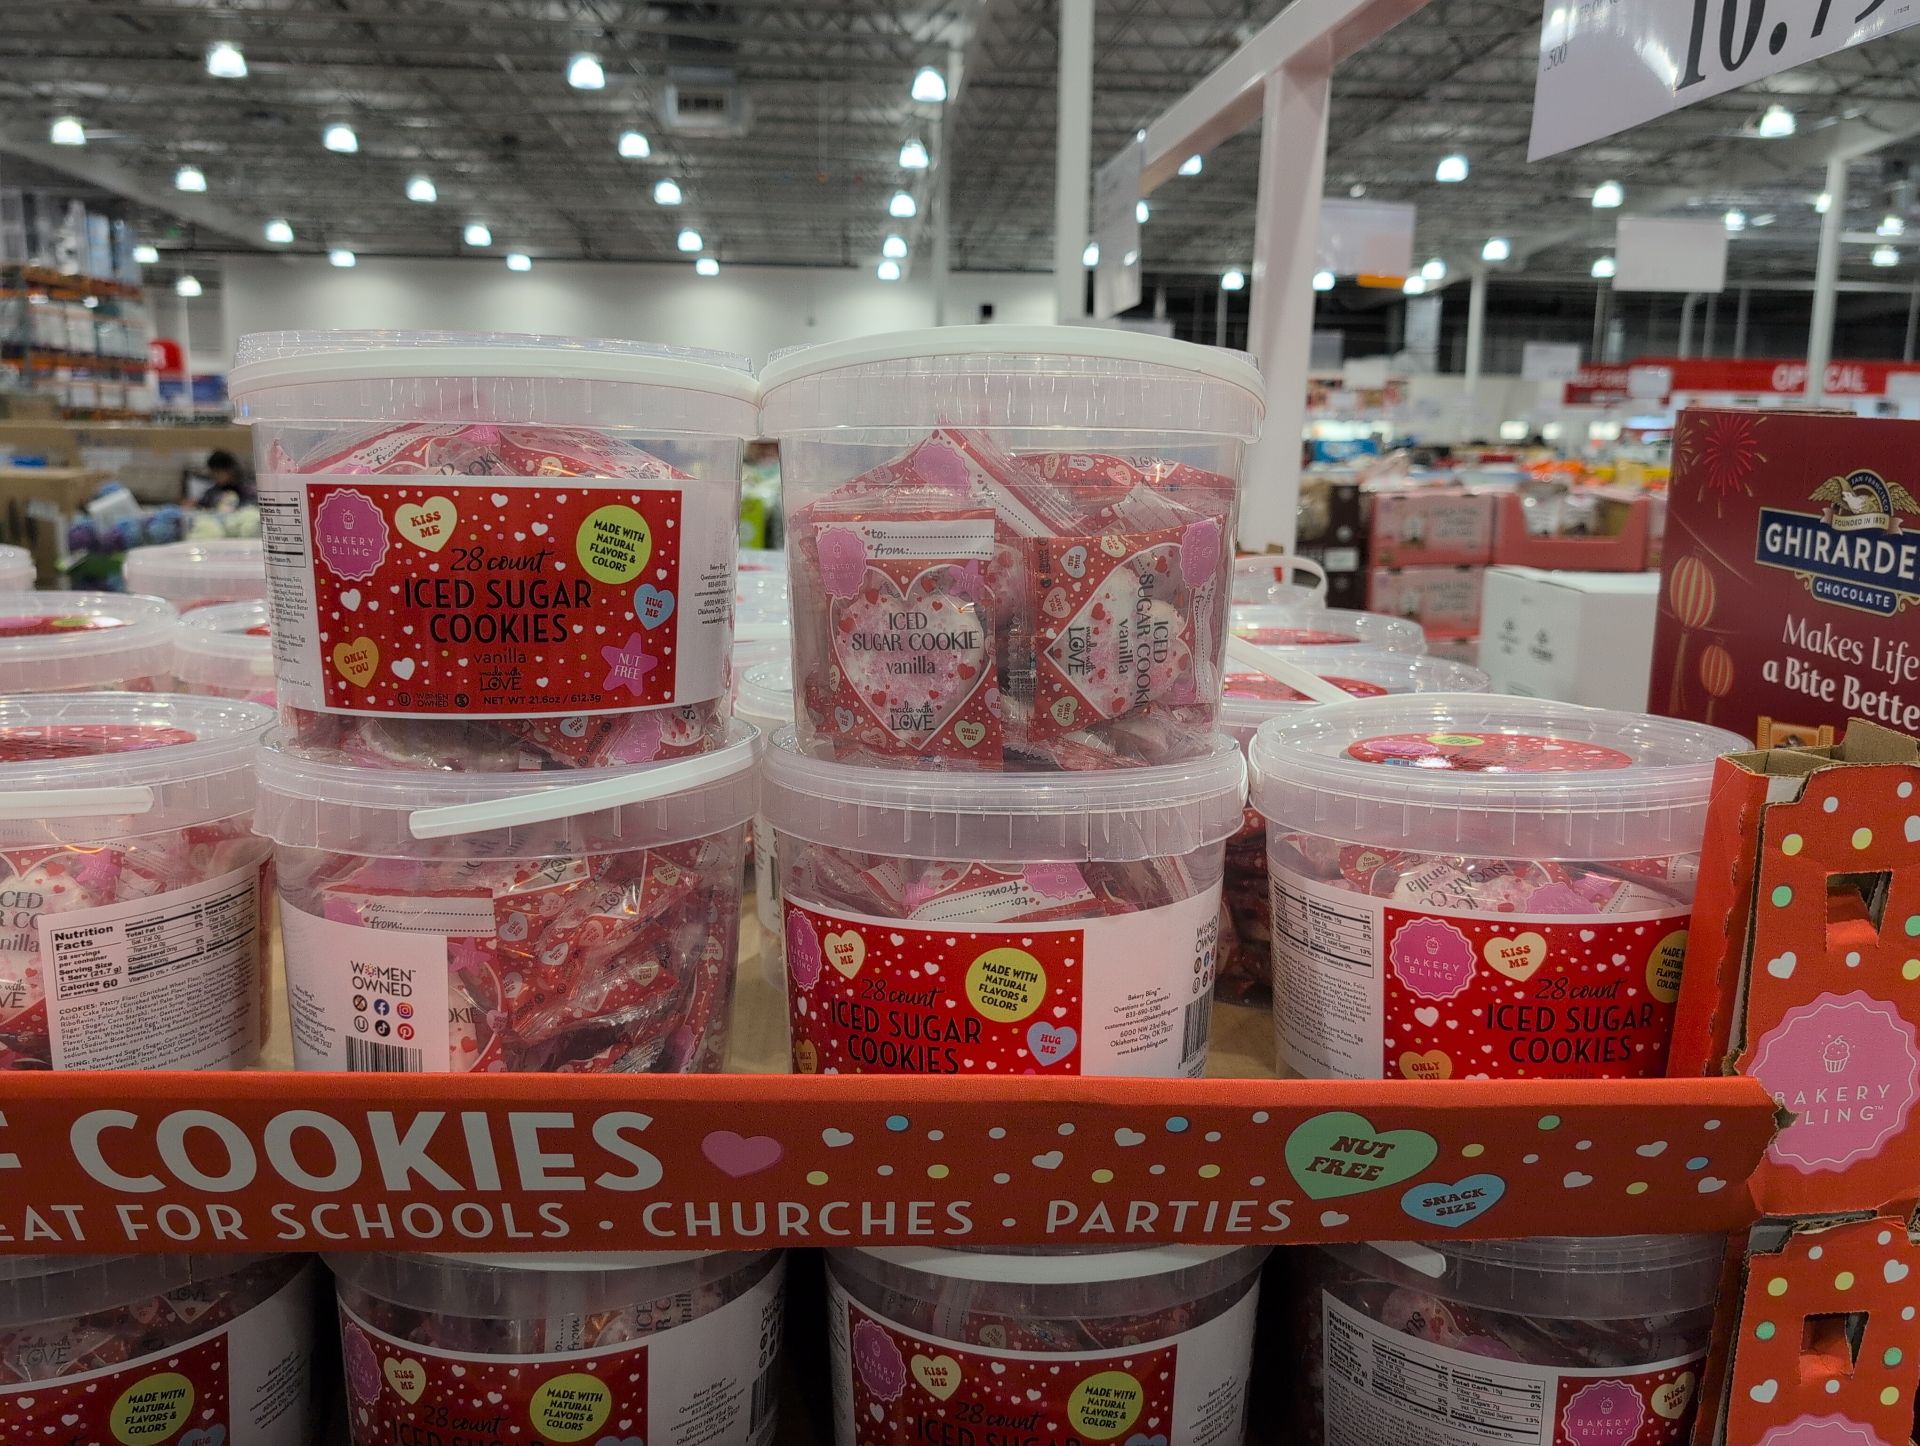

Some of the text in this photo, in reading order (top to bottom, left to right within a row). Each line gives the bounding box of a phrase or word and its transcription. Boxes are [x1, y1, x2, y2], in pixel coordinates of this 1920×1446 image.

[1772, 364, 1868, 392] OPCAL
[410, 511, 442, 527] KISS
[1834, 517, 1863, 527] FOUNDED
[1863, 517, 1871, 525] IN
[420, 525, 441, 539] ME
[594, 519, 645, 543] MADE WITH
[871, 529, 886, 541] to:
[326, 534, 375, 547] BAKERY
[596, 533, 636, 552] NATURAL
[589, 543, 637, 564] FLAVORS &
[873, 543, 909, 557] from:
[1765, 523, 1920, 580] GHIRARDE
[450, 546, 554, 573] 28 count
[592, 555, 627, 573] COLORS
[404, 578, 593, 610] ICED SUGAR
[1816, 581, 1891, 608] CHOCOLATE
[645, 596, 663, 609] HUG
[1136, 573, 1154, 638] SUGAR
[645, 608, 660, 618] ME
[429, 613, 568, 644] COOKIES
[888, 612, 928, 630] ICED
[851, 630, 981, 651] SUGAR COOKIE
[1119, 618, 1134, 675] vanilla
[1153, 620, 1169, 664] ICED
[474, 648, 528, 664] vanilla
[1068, 626, 1085, 677] LOVE
[1782, 613, 1920, 685] Makes Life
[343, 650, 369, 664] ONLY
[618, 652, 641, 665] NUT
[349, 662, 369, 675] YOU
[614, 666, 641, 681] FREE
[886, 656, 936, 676] vanilla
[480, 677, 522, 691] LOVE
[1762, 660, 1779, 683] a
[1784, 656, 1835, 703] Bite
[417, 700, 448, 708] OWNED
[484, 694, 601, 705] NET WT 21.6oz 612.3g
[889, 700, 933, 715] made with
[890, 714, 935, 731] LOVE
[961, 726, 980, 736] ONLY
[962, 733, 977, 741] YOU
[1406, 862, 1456, 892] vanilla
[371, 902, 384, 912] to:
[370, 917, 403, 929] from:
[54, 926, 113, 941] Nutrition
[126, 930, 144, 939] Total
[56, 940, 93, 951] Facts
[833, 943, 854, 954] KISS
[1500, 945, 1531, 959] KISS
[70, 950, 101, 960] servings
[74, 955, 107, 965] container
[128, 950, 166, 963] Cholesterol
[840, 955, 853, 966] ME
[59, 961, 112, 976] Serving Size
[128, 961, 154, 971] Sodium
[1404, 955, 1460, 972] BAKERY
[1508, 957, 1529, 969] ME
[90, 967, 111, 978] (21.7
[128, 973, 149, 983] Vitamin
[983, 961, 1038, 983] MADE WITH
[60, 978, 118, 992] Calories 60
[352, 976, 412, 997] OWNED
[985, 974, 1027, 992] NATURAL
[1535, 977, 1627, 1000] 28 count
[74, 988, 98, 996] serving
[861, 978, 945, 1009] 28 count
[979, 983, 1028, 1003] FLAVORS &
[1128, 993, 1144, 1001] Bakery
[59, 1003, 97, 1015] COOKIES:
[981, 995, 1018, 1011] COLORS
[1113, 993, 1171, 1013] Questions Comments?
[831, 997, 983, 1045] ICED SUGAR
[1486, 1002, 1654, 1034] ICED SUGAR
[1137, 1022, 1160, 1034] NW 23rd
[1040, 1033, 1061, 1045] HUG
[1110, 1037, 1138, 1048] Oklahoma
[1152, 1029, 1160, 1037] OK
[847, 1034, 959, 1074] COOKIES
[1040, 1044, 1056, 1054] ME
[1117, 1038, 1168, 1056] www.bakerybling.com
[1508, 1036, 1632, 1064] COOKIES
[1411, 1061, 1439, 1071] ONLY
[1774, 1083, 1891, 1105] BAKERY
[70, 1109, 664, 1193] COOKIES
[1329, 1136, 1396, 1159] NUT
[1305, 1156, 1384, 1181] FREE
[1422, 1187, 1487, 1208] SNACK
[1435, 1201, 1477, 1217] SIZE
[118, 1204, 244, 1241] FOR
[271, 1202, 571, 1240] SCHOOLS
[642, 1201, 974, 1238] CHURCHES
[1046, 1199, 1293, 1235] PARTIES
[393, 1370, 415, 1381] KISS
[923, 1366, 948, 1377] KISS
[400, 1381, 415, 1390] ME
[931, 1377, 947, 1387] ME
[128, 1388, 186, 1405] MADE WITH
[547, 1387, 603, 1402] MADE WITH
[1085, 1386, 1137, 1400] MADE WITH
[1663, 1384, 1685, 1403] KISS
[131, 1402, 176, 1415] NATURAL
[550, 1399, 593, 1412] NATURAL
[1087, 1398, 1126, 1410] NATURAL
[1669, 1396, 1683, 1410] ME
[124, 1410, 177, 1425] FLAVORS &
[423, 1405, 509, 1434] 28 count
[544, 1408, 594, 1421] FLAVORS &
[955, 1401, 1043, 1432] 28 count
[1080, 1407, 1127, 1420] FLAVORS &
[1451, 1410, 1476, 1420] Protein
[128, 1423, 167, 1435] COLORS
[546, 1419, 584, 1431] COLORS
[1082, 1417, 1117, 1429] COLORS
[1577, 1418, 1631, 1427] BAKERY
